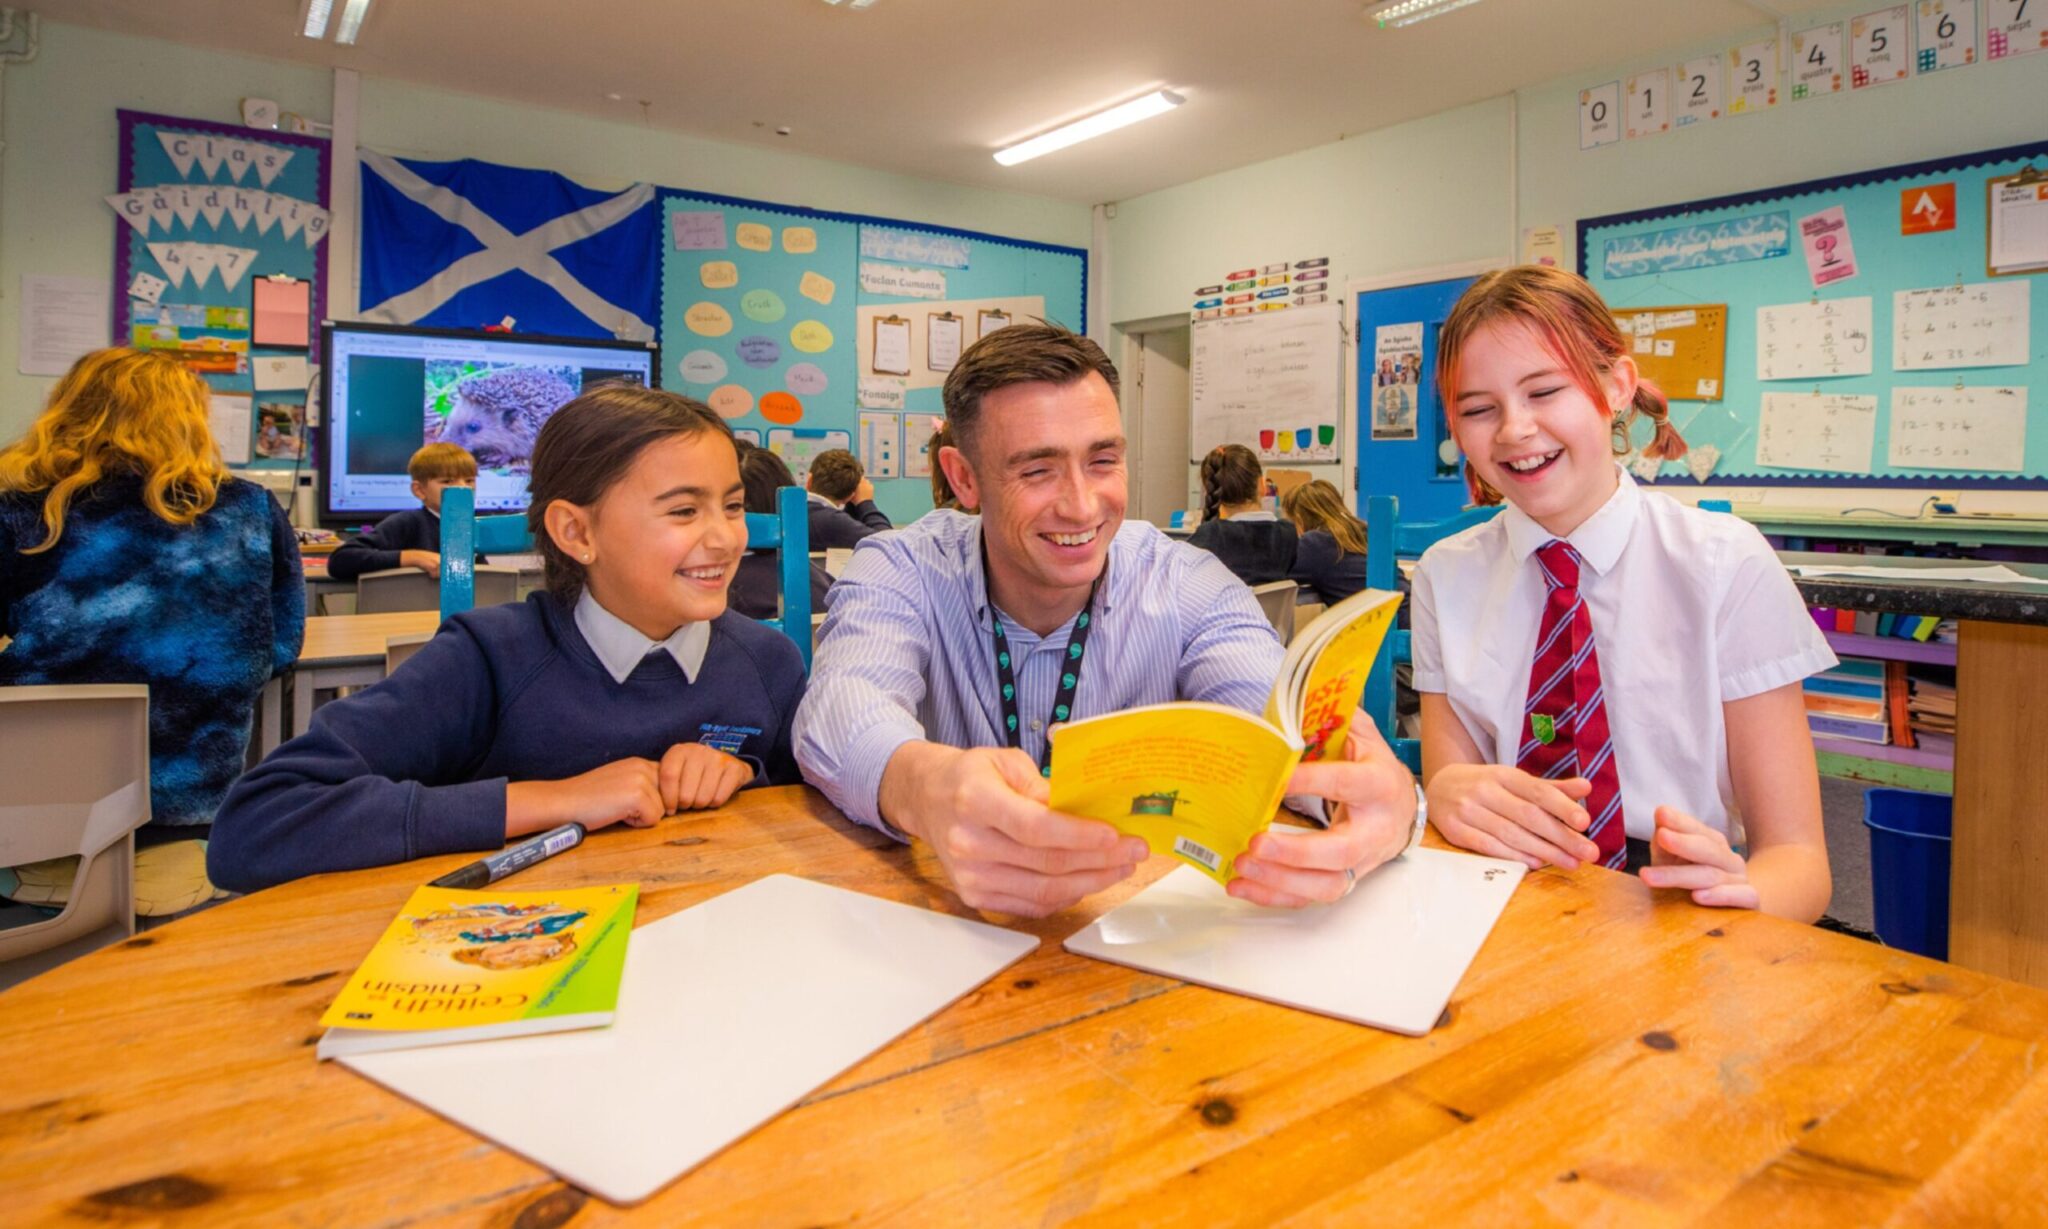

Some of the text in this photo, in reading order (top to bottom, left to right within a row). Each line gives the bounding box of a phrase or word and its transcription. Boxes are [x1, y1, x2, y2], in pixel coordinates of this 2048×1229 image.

[1937, 14, 1956, 39] 6
[1870, 27, 1888, 52] 5
[1938, 39, 1955, 51] six
[1807, 44, 1826, 66] 4
[1866, 52, 1892, 66] cinq
[1746, 59, 1762, 83] 3
[1800, 65, 1834, 80] quatre
[1691, 74, 1707, 98] 2
[1643, 88, 1652, 109] 1
[1591, 101, 1607, 122] 0
[174, 139, 276, 167] Clas
[125, 189, 323, 232] Gàidhlig
[363, 980, 482, 996] Chidsin
[393, 993, 528, 1013] Ceitidh
